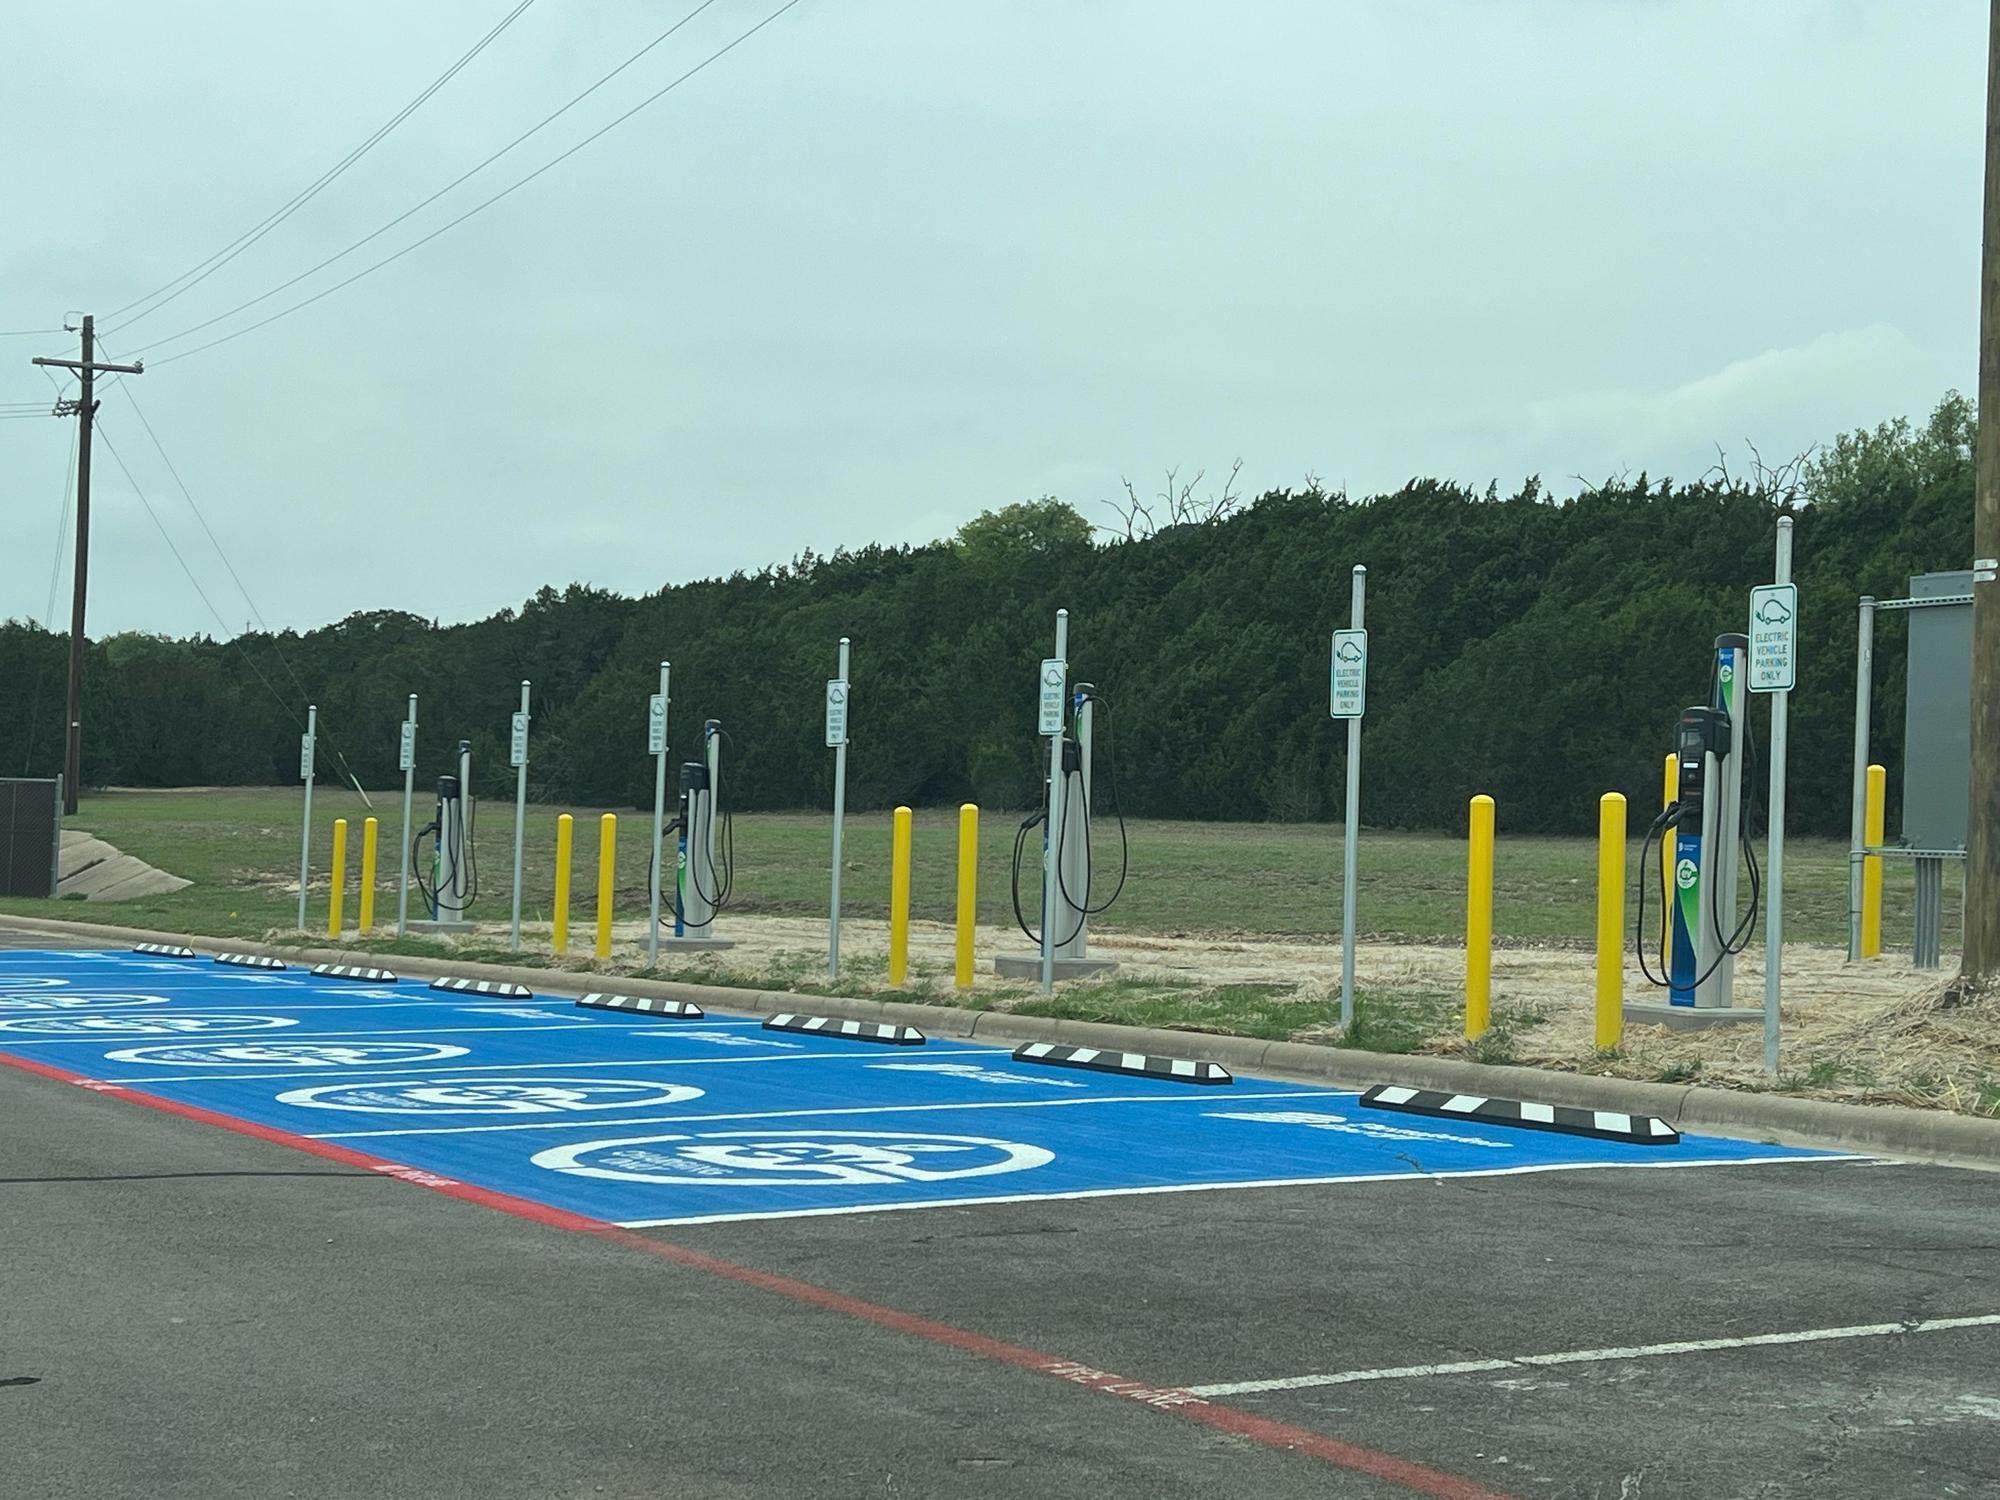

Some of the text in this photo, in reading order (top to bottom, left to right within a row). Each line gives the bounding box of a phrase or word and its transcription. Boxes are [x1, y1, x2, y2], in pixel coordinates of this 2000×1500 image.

[1755, 631, 1788, 643] ELECTRIC
[1757, 644, 1787, 655] VEHICLE
[1755, 657, 1787, 668] PARKING
[1336, 668, 1360, 677] ELECTRIC
[1761, 671, 1781, 680] ONLY
[1337, 679, 1359, 688] VEHICLE
[1336, 690, 1359, 698] PARKING
[1340, 701, 1354, 709] ONLY
